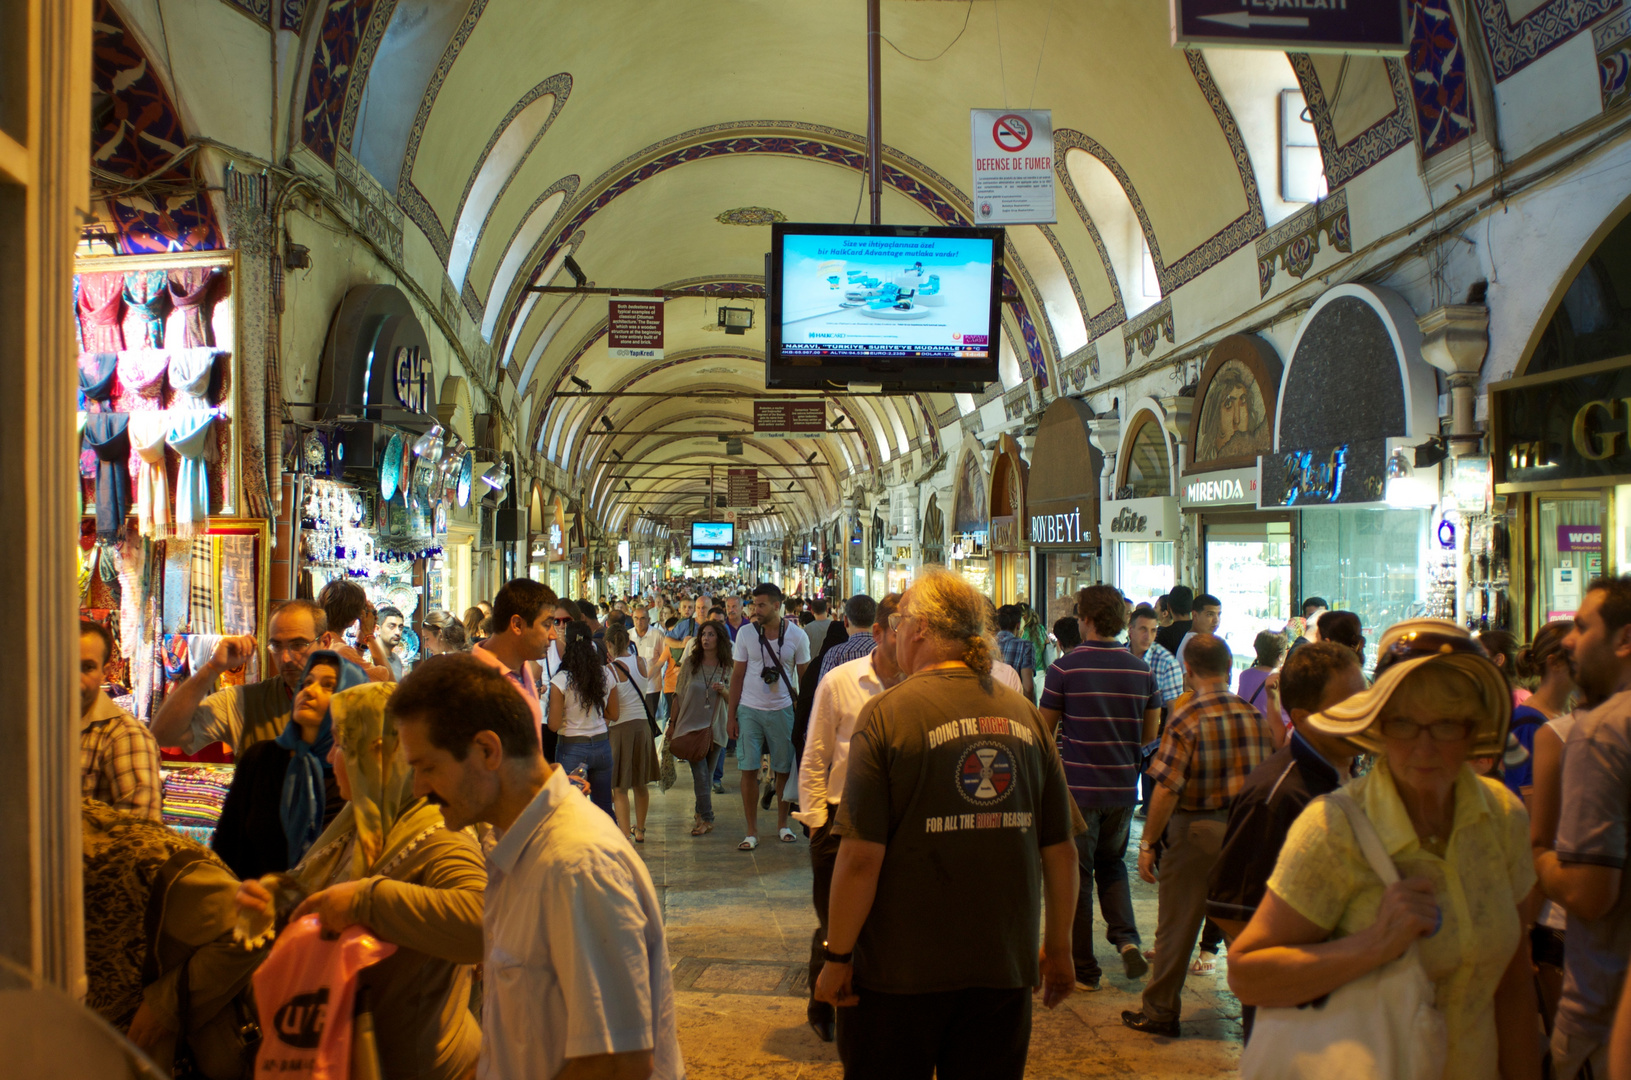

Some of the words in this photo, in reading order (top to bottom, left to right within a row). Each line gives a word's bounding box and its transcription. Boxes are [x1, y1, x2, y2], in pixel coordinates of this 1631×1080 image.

[976, 158, 1010, 170] DEFENSE
[1012, 158, 1022, 170] DE
[1025, 157, 1051, 170] FUMER
[865, 250, 903, 258] Advantage
[1509, 441, 1540, 468] 171
[1188, 478, 1244, 502] MİRENDA
[1032, 506, 1081, 542] BOYBEYİ
[1111, 506, 1147, 532] elite
[928, 720, 960, 749] DOING
[960, 718, 979, 736] THE
[979, 716, 1009, 734] RIGHT
[1009, 719, 1033, 746] THING
[926, 818, 943, 832] FOR
[944, 815, 958, 830] ALL
[960, 814, 975, 829] THE
[976, 813, 1001, 828] RIGHT
[1003, 812, 1032, 828] REASONS
